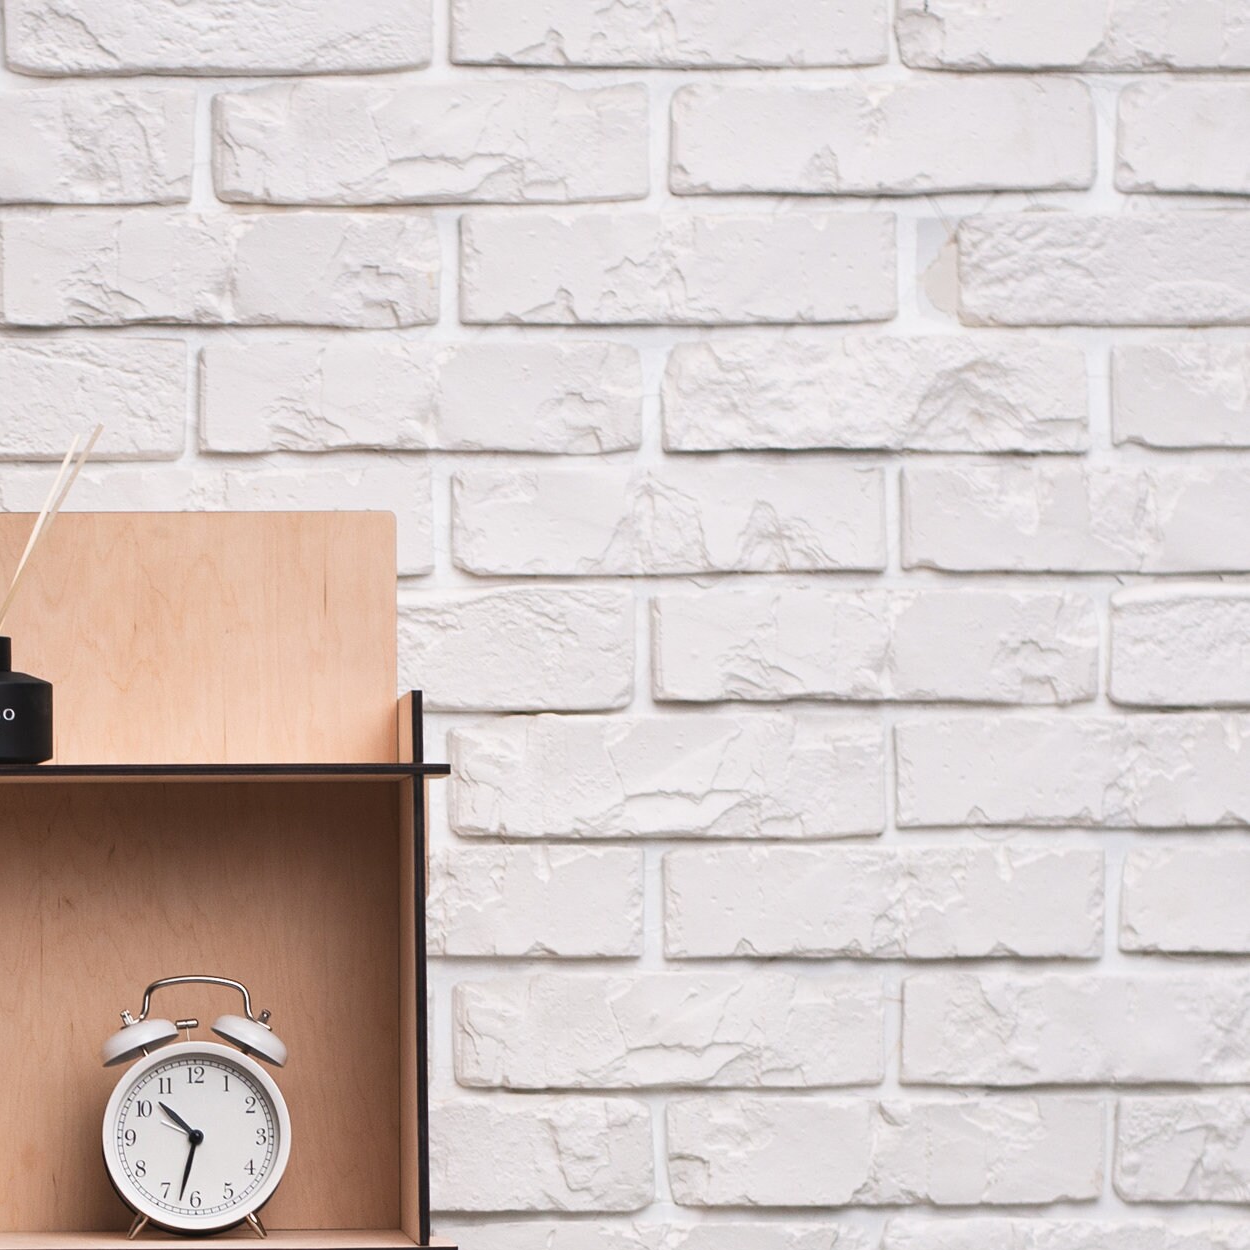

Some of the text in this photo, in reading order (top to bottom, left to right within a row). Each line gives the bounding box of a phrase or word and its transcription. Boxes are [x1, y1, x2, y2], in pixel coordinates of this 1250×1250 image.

[187, 1067, 204, 1084] 12
[224, 1075, 229, 1092] 1
[158, 1078, 172, 1094] 11
[137, 1100, 152, 1117] 10
[246, 1097, 255, 1113] 2
[125, 1129, 136, 1146] 9
[256, 1128, 266, 1145] 3
[136, 1160, 146, 1177] 8
[245, 1159, 255, 1175] 4
[161, 1183, 171, 1199] 7
[190, 1191, 201, 1208] 6
[223, 1183, 233, 1200] 5
